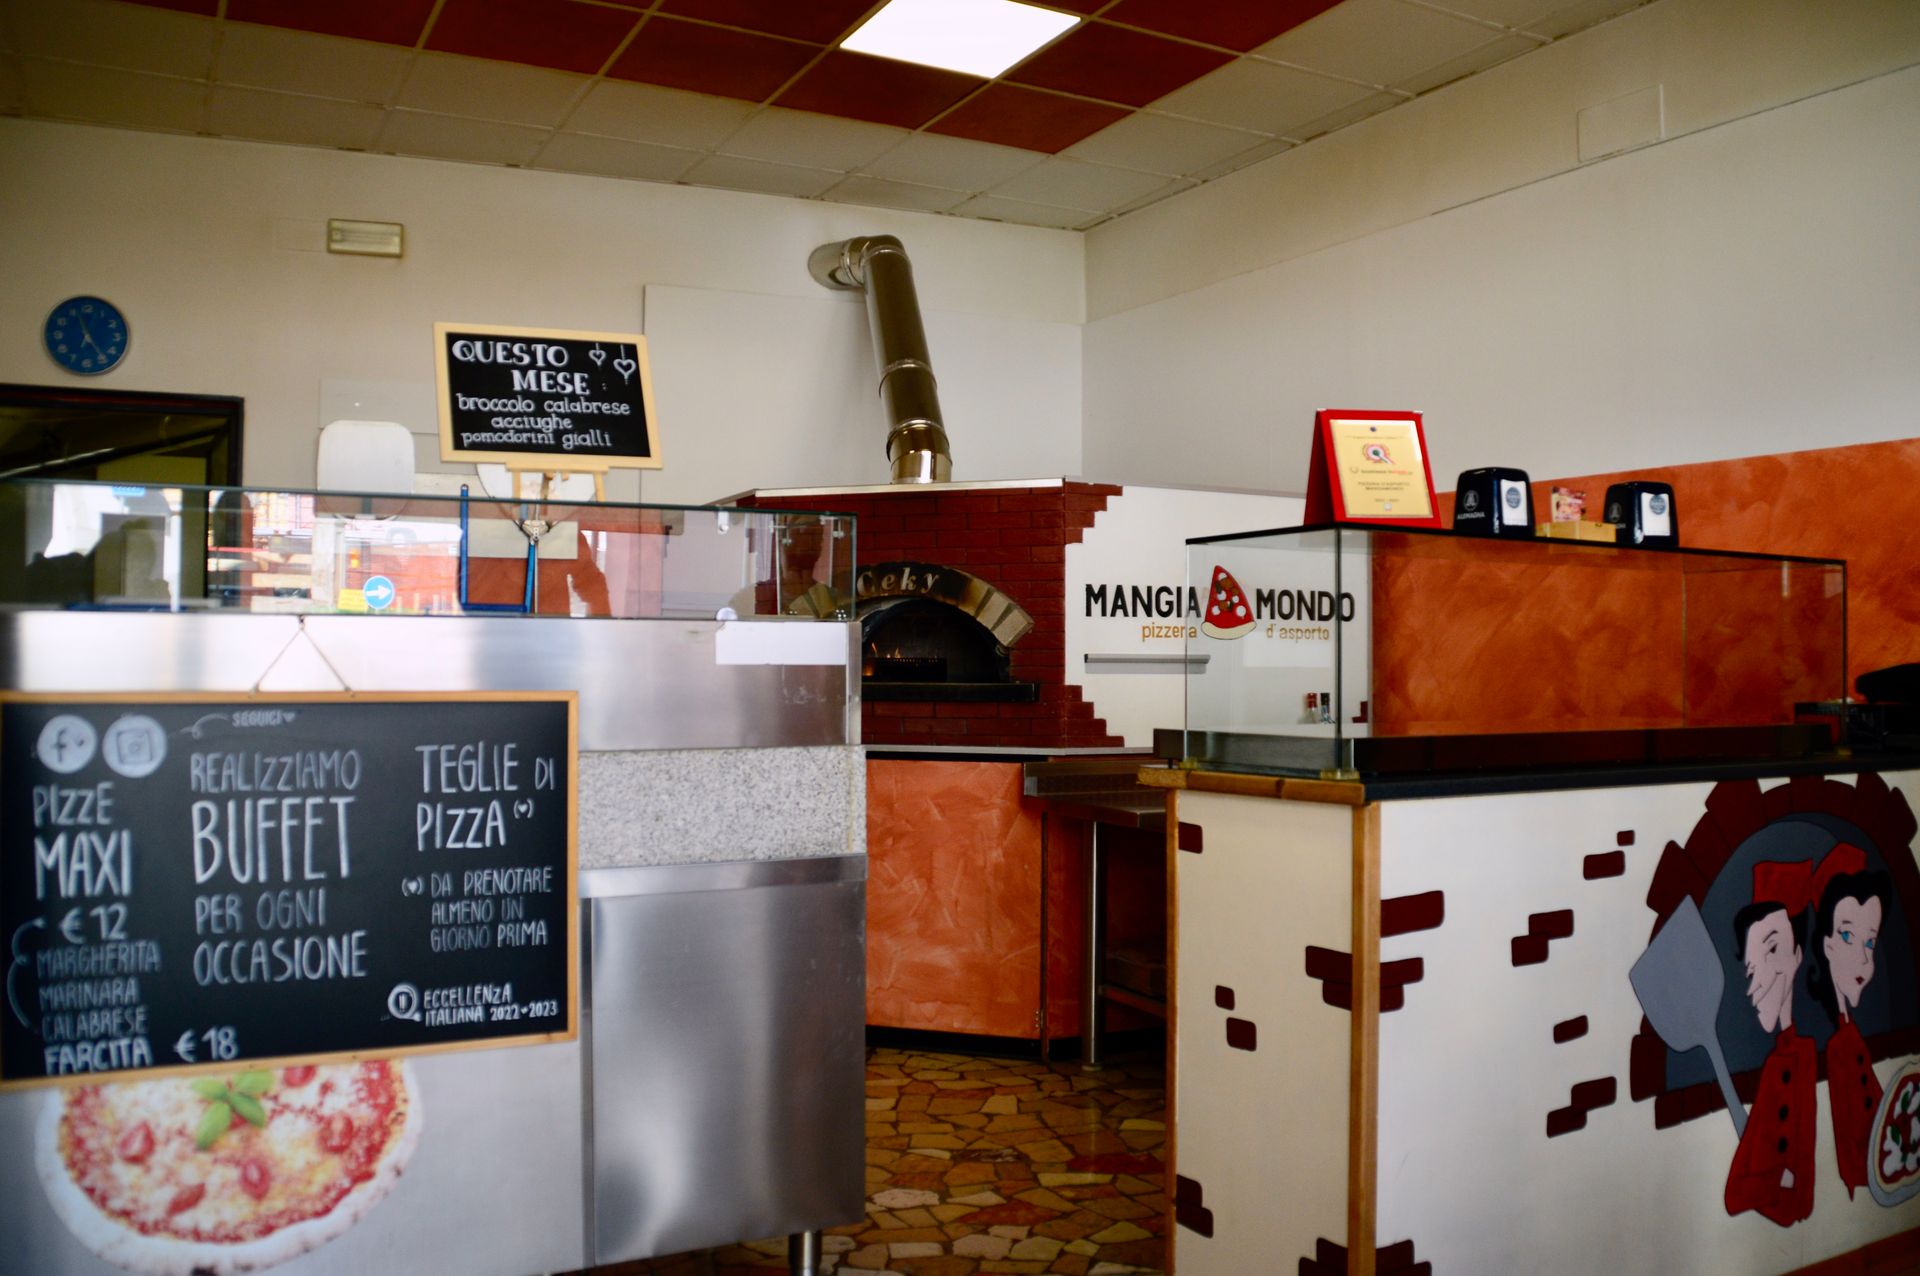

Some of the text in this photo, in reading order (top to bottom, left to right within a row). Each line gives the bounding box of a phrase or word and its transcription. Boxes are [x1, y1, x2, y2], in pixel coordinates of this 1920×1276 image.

[452, 339, 569, 367] QUESTO
[511, 369, 590, 395] MESE
[456, 393, 631, 414] broccolo calabrese
[460, 430, 613, 450] pomodorini gialli
[491, 414, 573, 433] acciughe
[857, 567, 939, 597] Ceky
[1085, 584, 1355, 622] MANGIA MONDO
[1142, 622, 1198, 642] pizzera
[190, 750, 361, 793] REALIZZIAMO
[415, 741, 556, 793] TEGLIE DI
[33, 782, 114, 828] PIZZE
[191, 796, 355, 885] BUFFET
[417, 800, 506, 852] PIZZA
[34, 829, 132, 899] MAXI
[431, 866, 553, 898] DA PRENOTARE
[60, 903, 128, 944] € 12
[195, 886, 326, 935] PER OGNI
[432, 896, 524, 924] ALMENO UN
[430, 919, 548, 952] GIORNO PRIMA
[37, 939, 161, 977] MARGHERITA
[193, 930, 368, 987] OCCASIONE
[39, 975, 139, 1011] MARINARA
[42, 1004, 148, 1043] CALABRESE
[425, 1006, 484, 1027] ITALIANA
[44, 1036, 152, 1076] FARCITA
[174, 1025, 238, 1063] € 18
